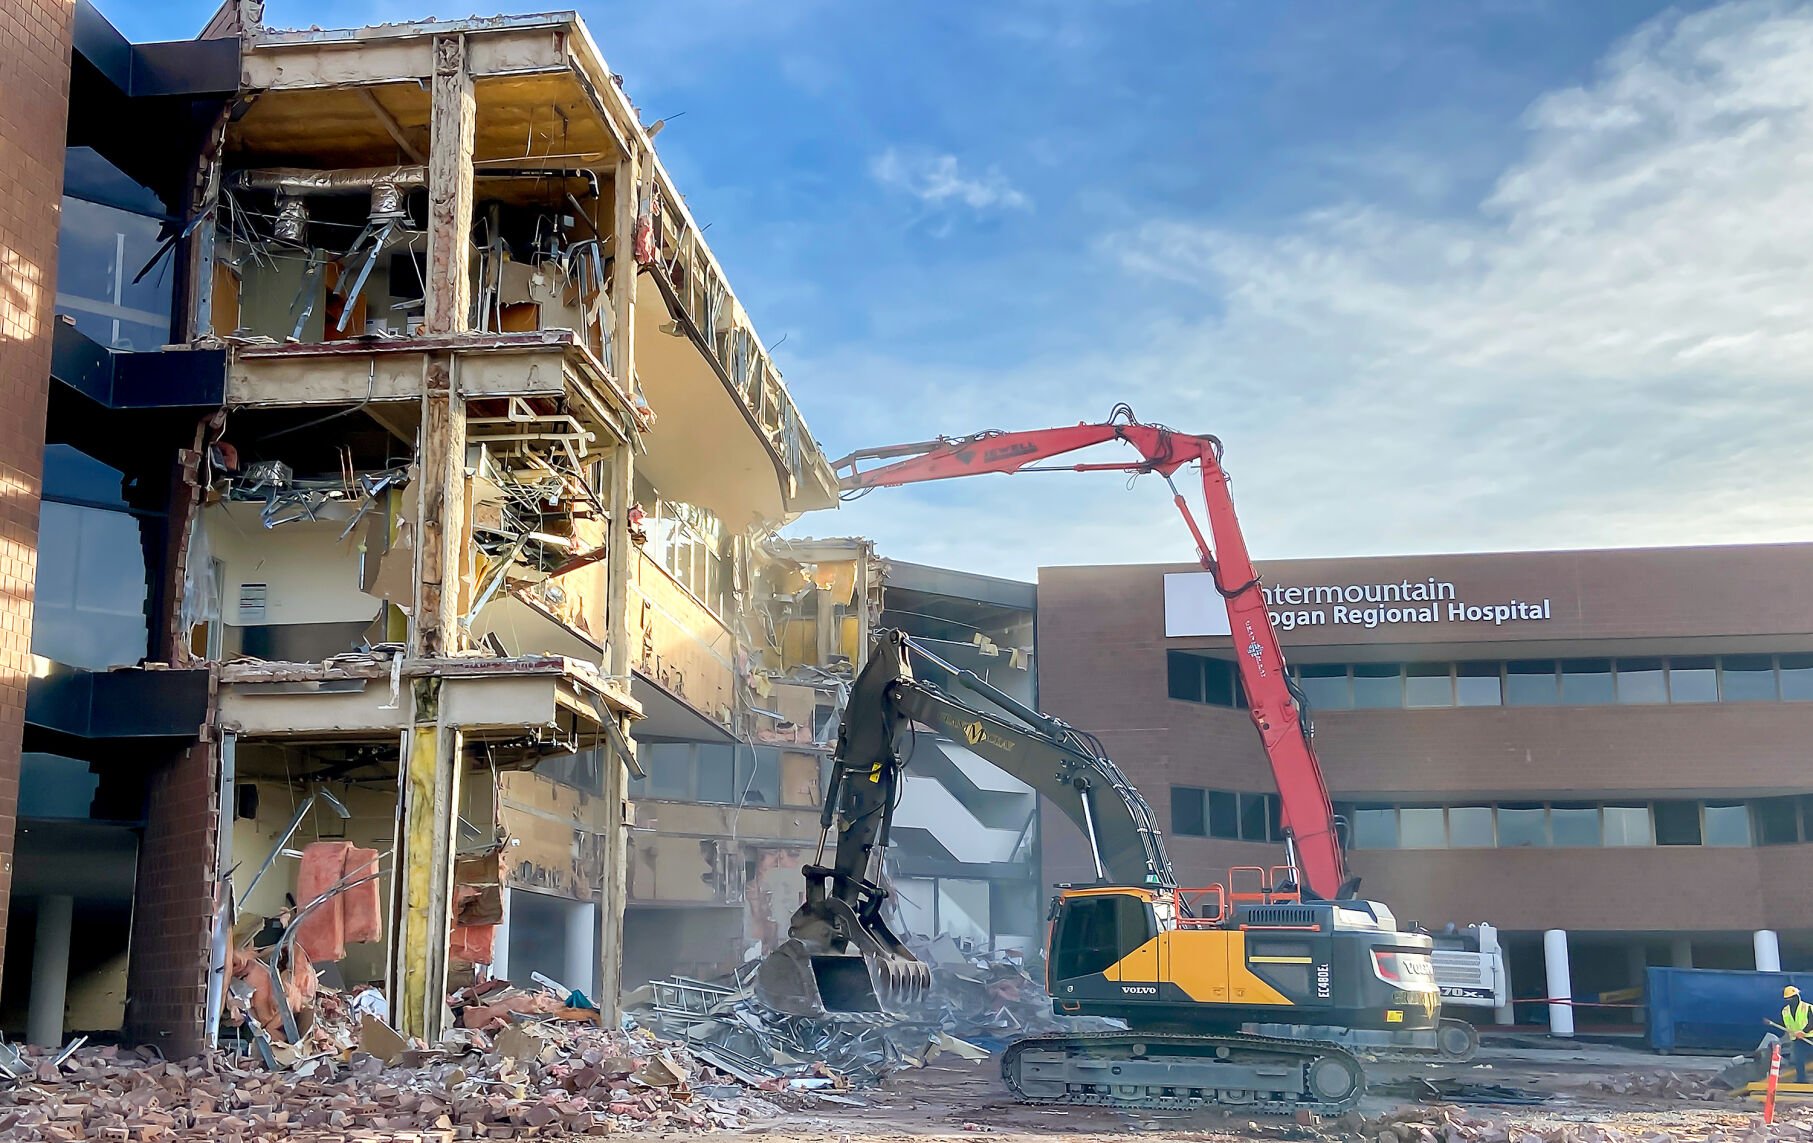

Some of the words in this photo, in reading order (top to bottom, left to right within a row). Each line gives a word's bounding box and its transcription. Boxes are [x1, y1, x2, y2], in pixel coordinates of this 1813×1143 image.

[1262, 577, 1455, 605] ntermountain
[1268, 610, 1325, 631] ogan
[1333, 602, 1439, 628] Regional
[1448, 599, 1550, 625] Hospital
[1121, 986, 1157, 994] VOLVO
[1441, 987, 1484, 998] 70X
